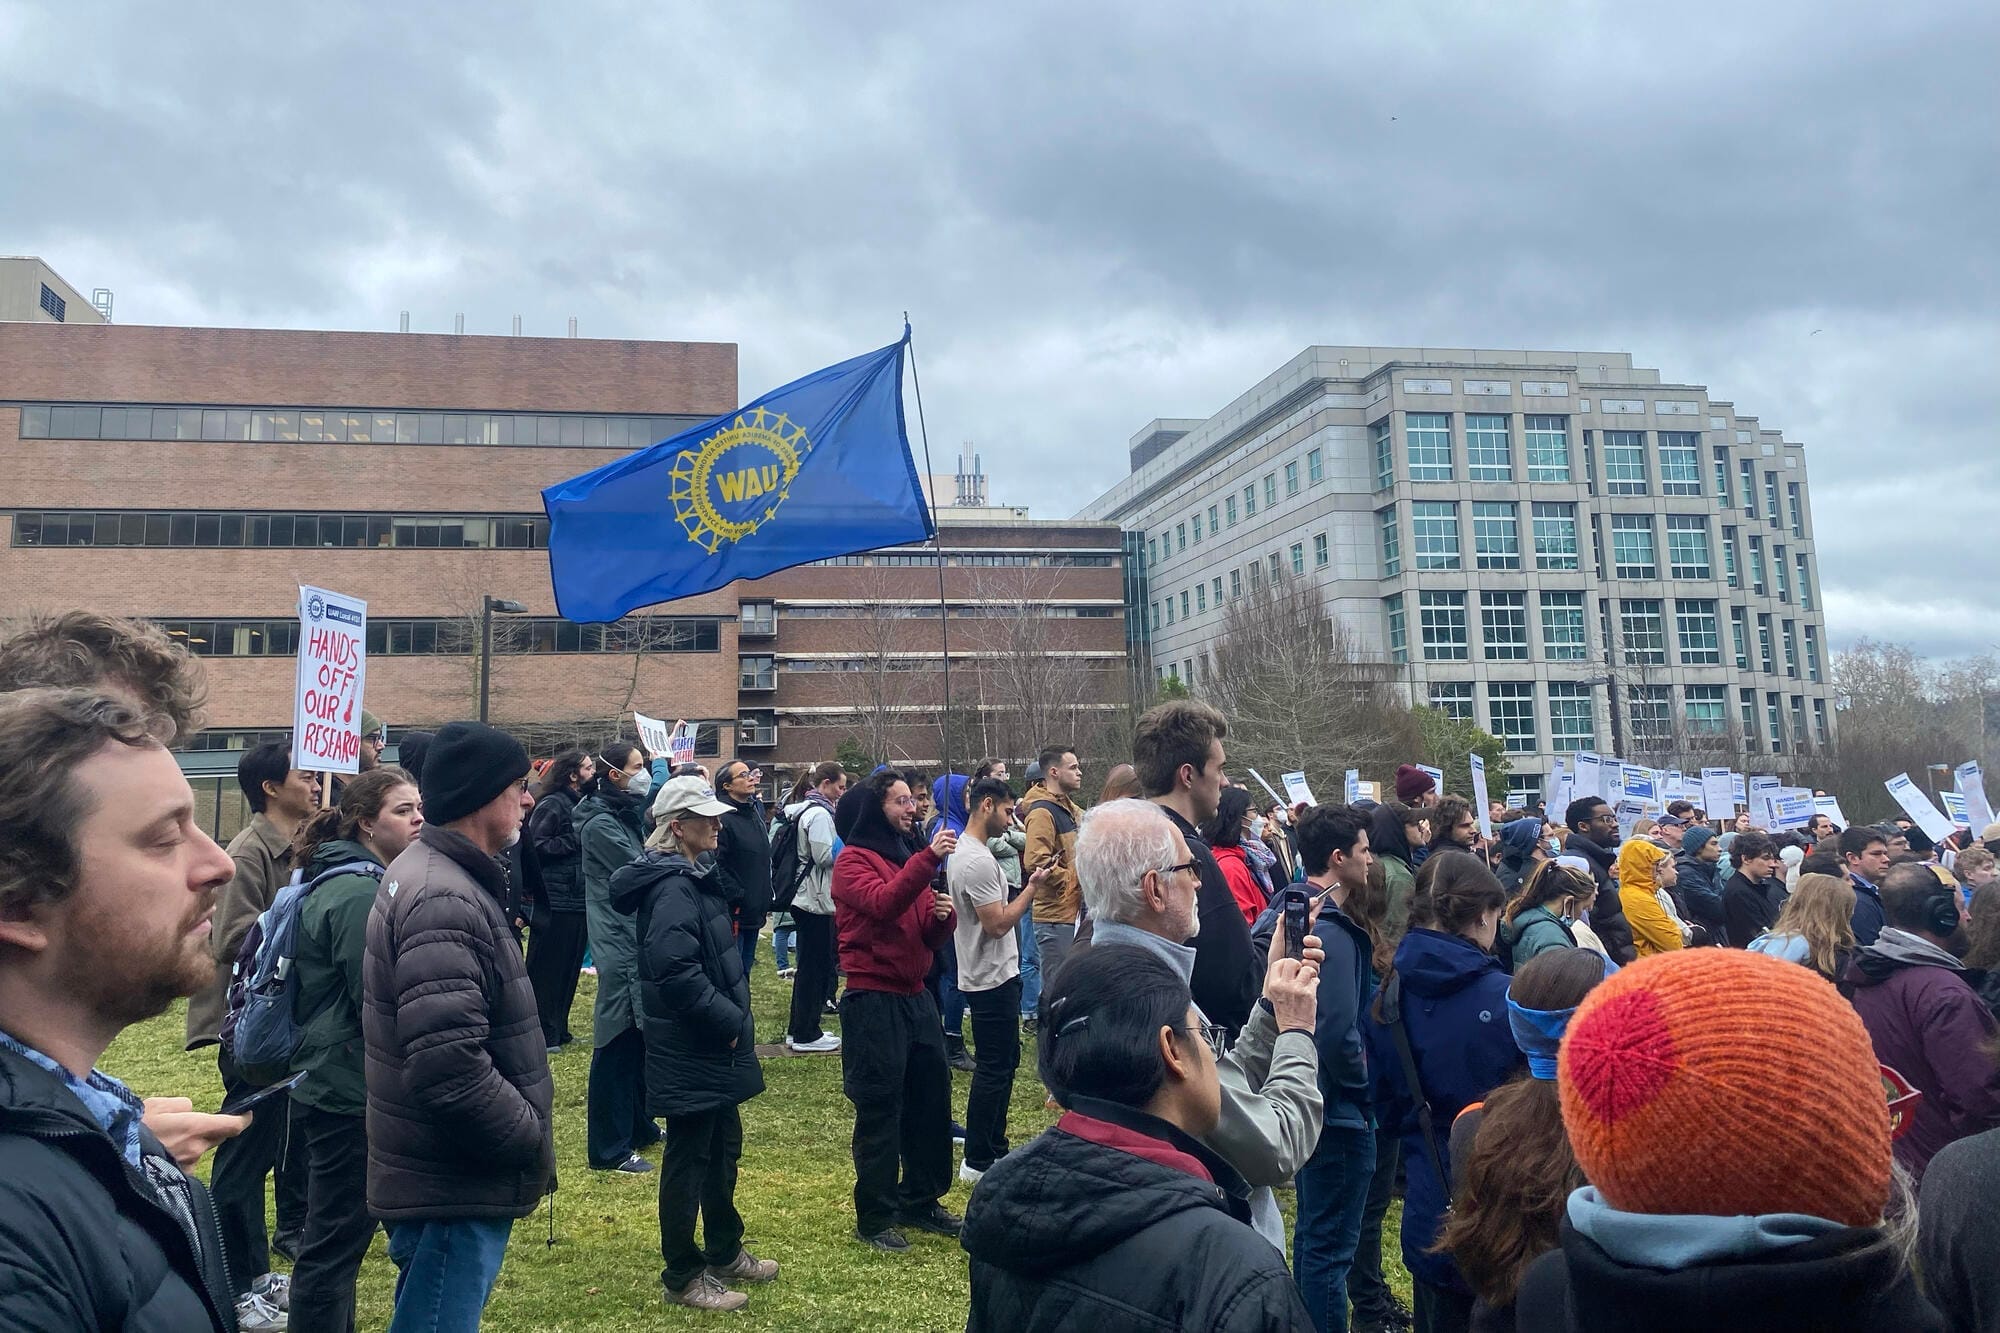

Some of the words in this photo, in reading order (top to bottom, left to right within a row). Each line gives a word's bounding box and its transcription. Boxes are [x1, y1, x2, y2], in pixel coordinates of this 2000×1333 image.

[308, 626, 360, 673] HANDS
[318, 664, 354, 696] OFF
[305, 690, 340, 723] OUR
[304, 722, 360, 764] RESEARCH
